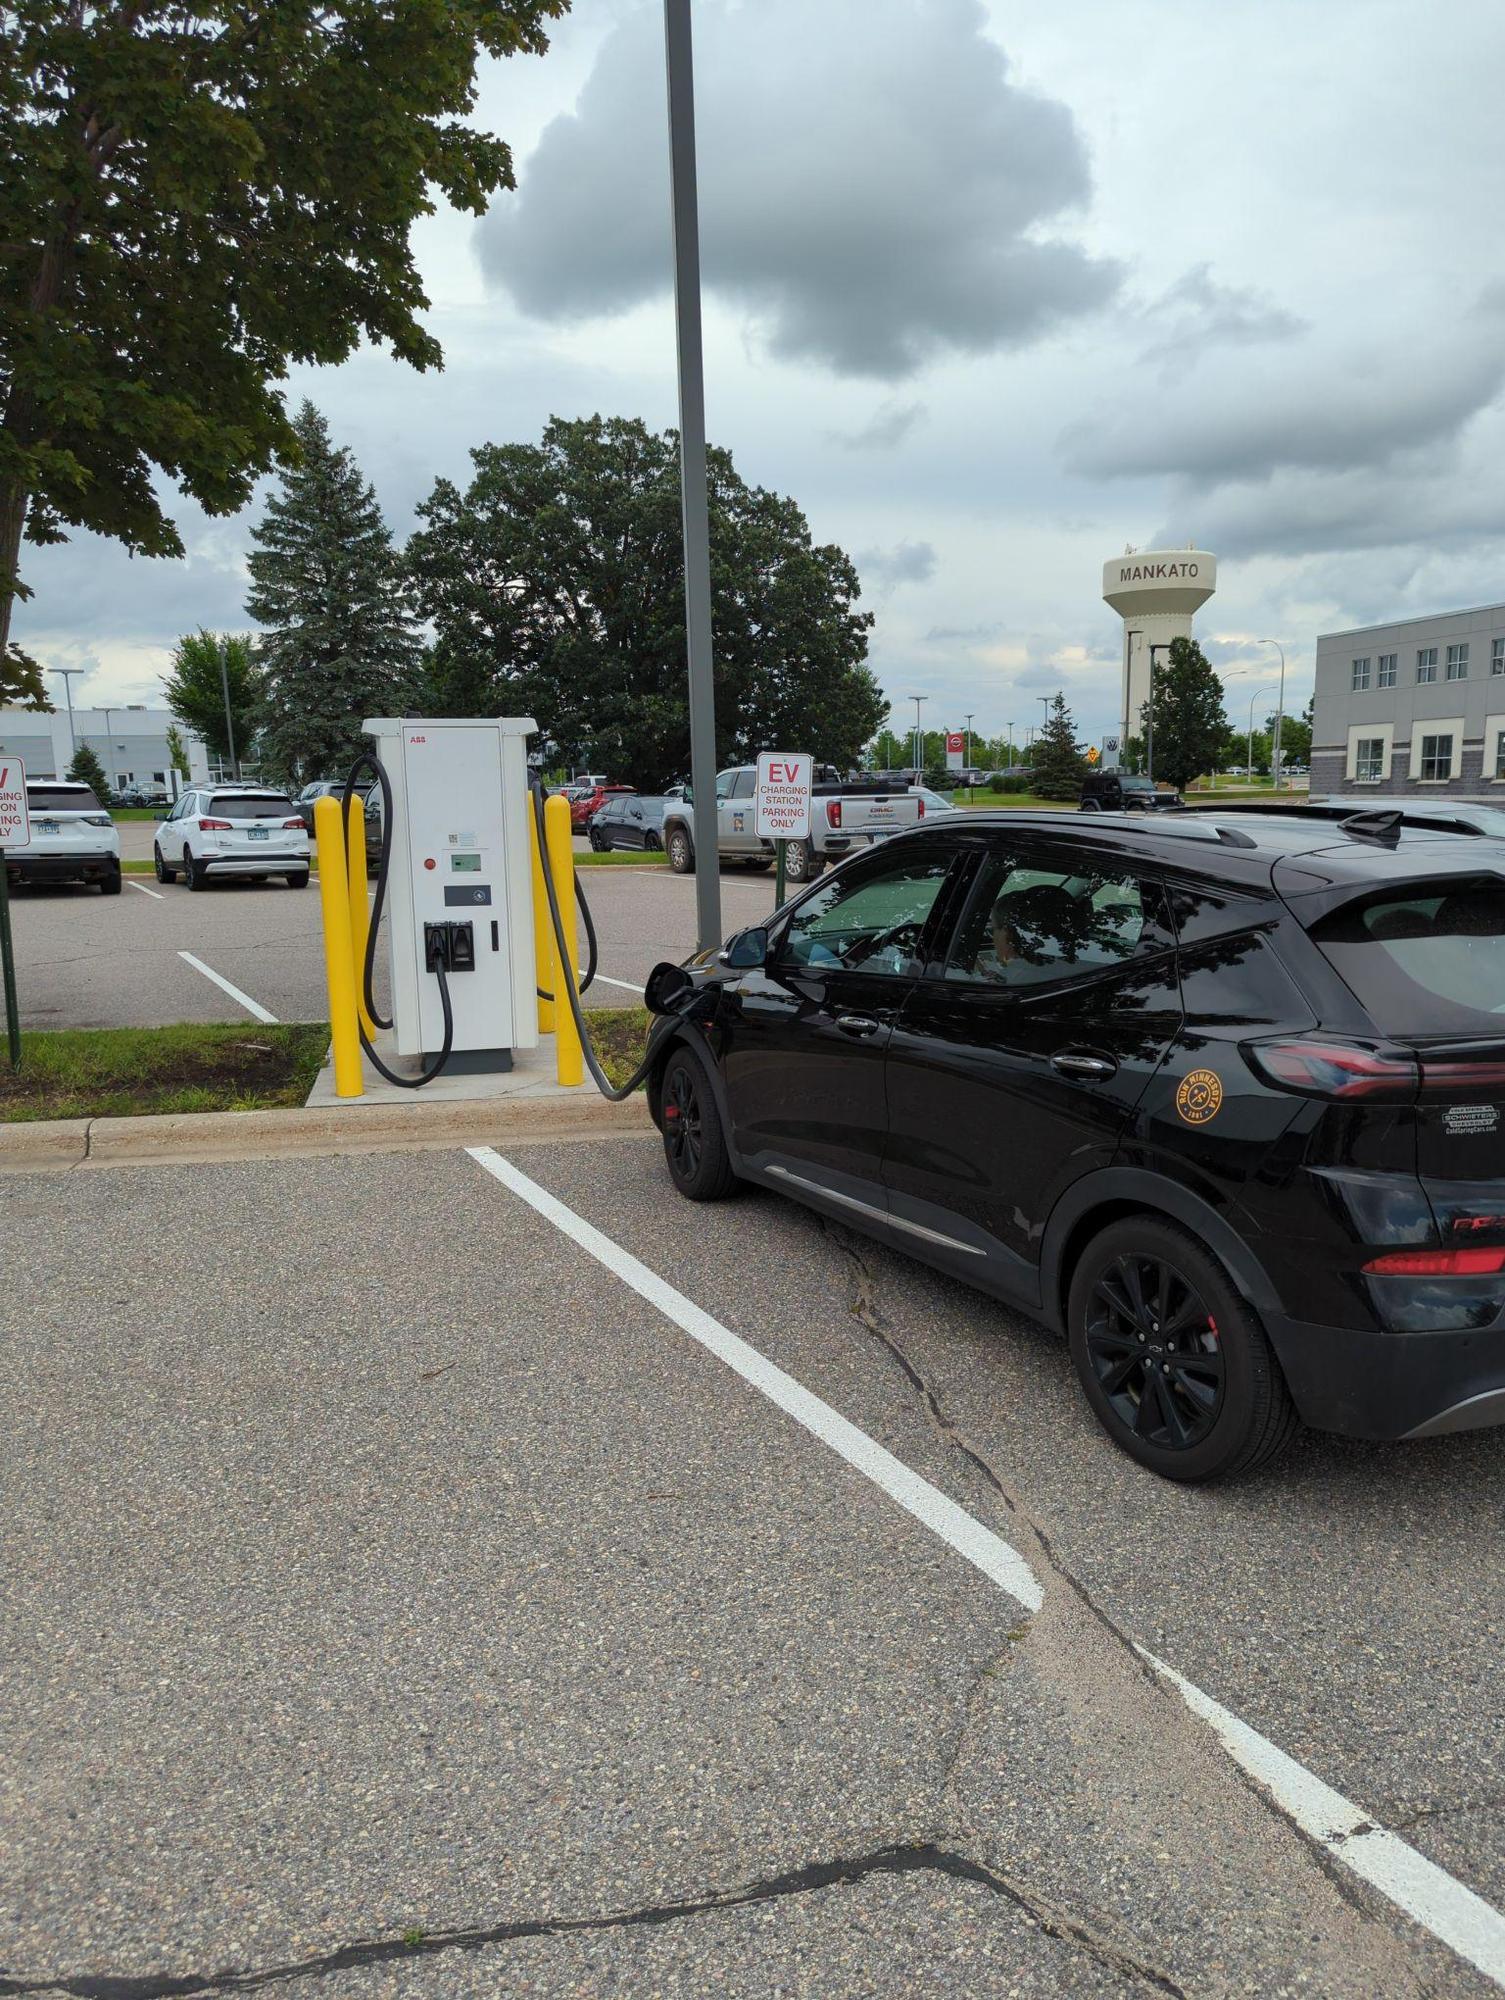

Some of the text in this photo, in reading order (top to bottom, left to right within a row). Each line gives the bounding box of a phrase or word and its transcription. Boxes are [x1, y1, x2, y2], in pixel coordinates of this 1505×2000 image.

[1120, 563, 1198, 582] MANKATO
[769, 763, 799, 783] EV
[760, 785, 807, 795] CHARGING
[765, 796, 802, 805] STATION
[762, 808, 805, 817] PARKING
[770, 819, 795, 828] ONLY
[1179, 1072, 1220, 1109] RUN MINNESOTA
